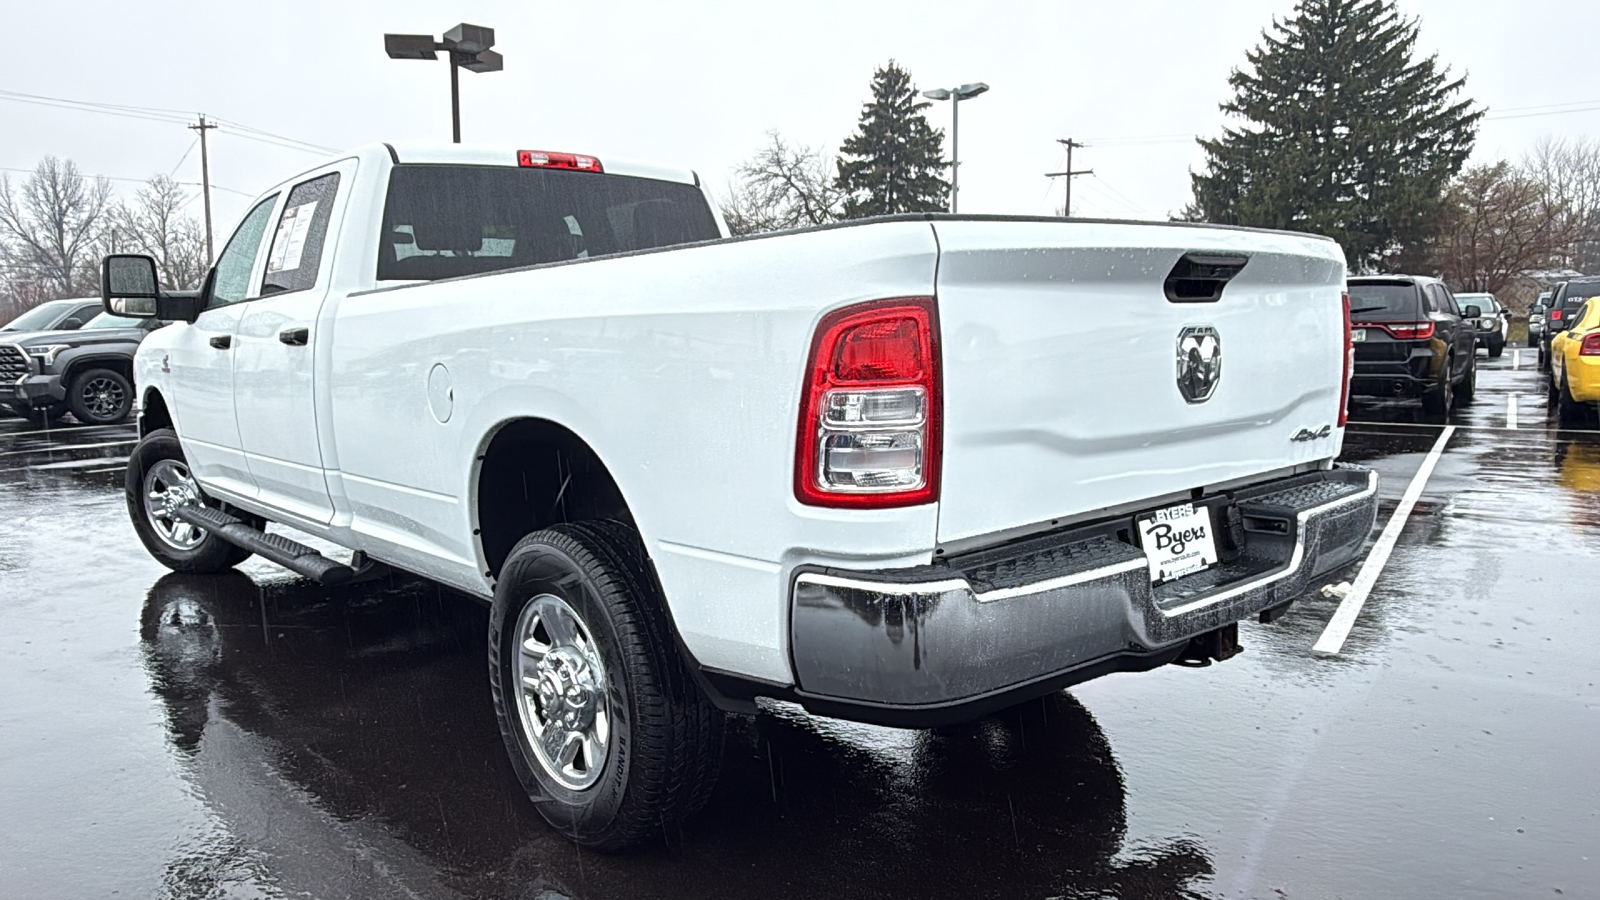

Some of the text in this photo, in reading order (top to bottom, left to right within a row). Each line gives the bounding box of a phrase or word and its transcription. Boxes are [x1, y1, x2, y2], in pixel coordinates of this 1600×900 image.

[1187, 326, 1213, 334] RAM
[1156, 503, 1193, 522] BYERS
[1145, 523, 1206, 555] Byers
